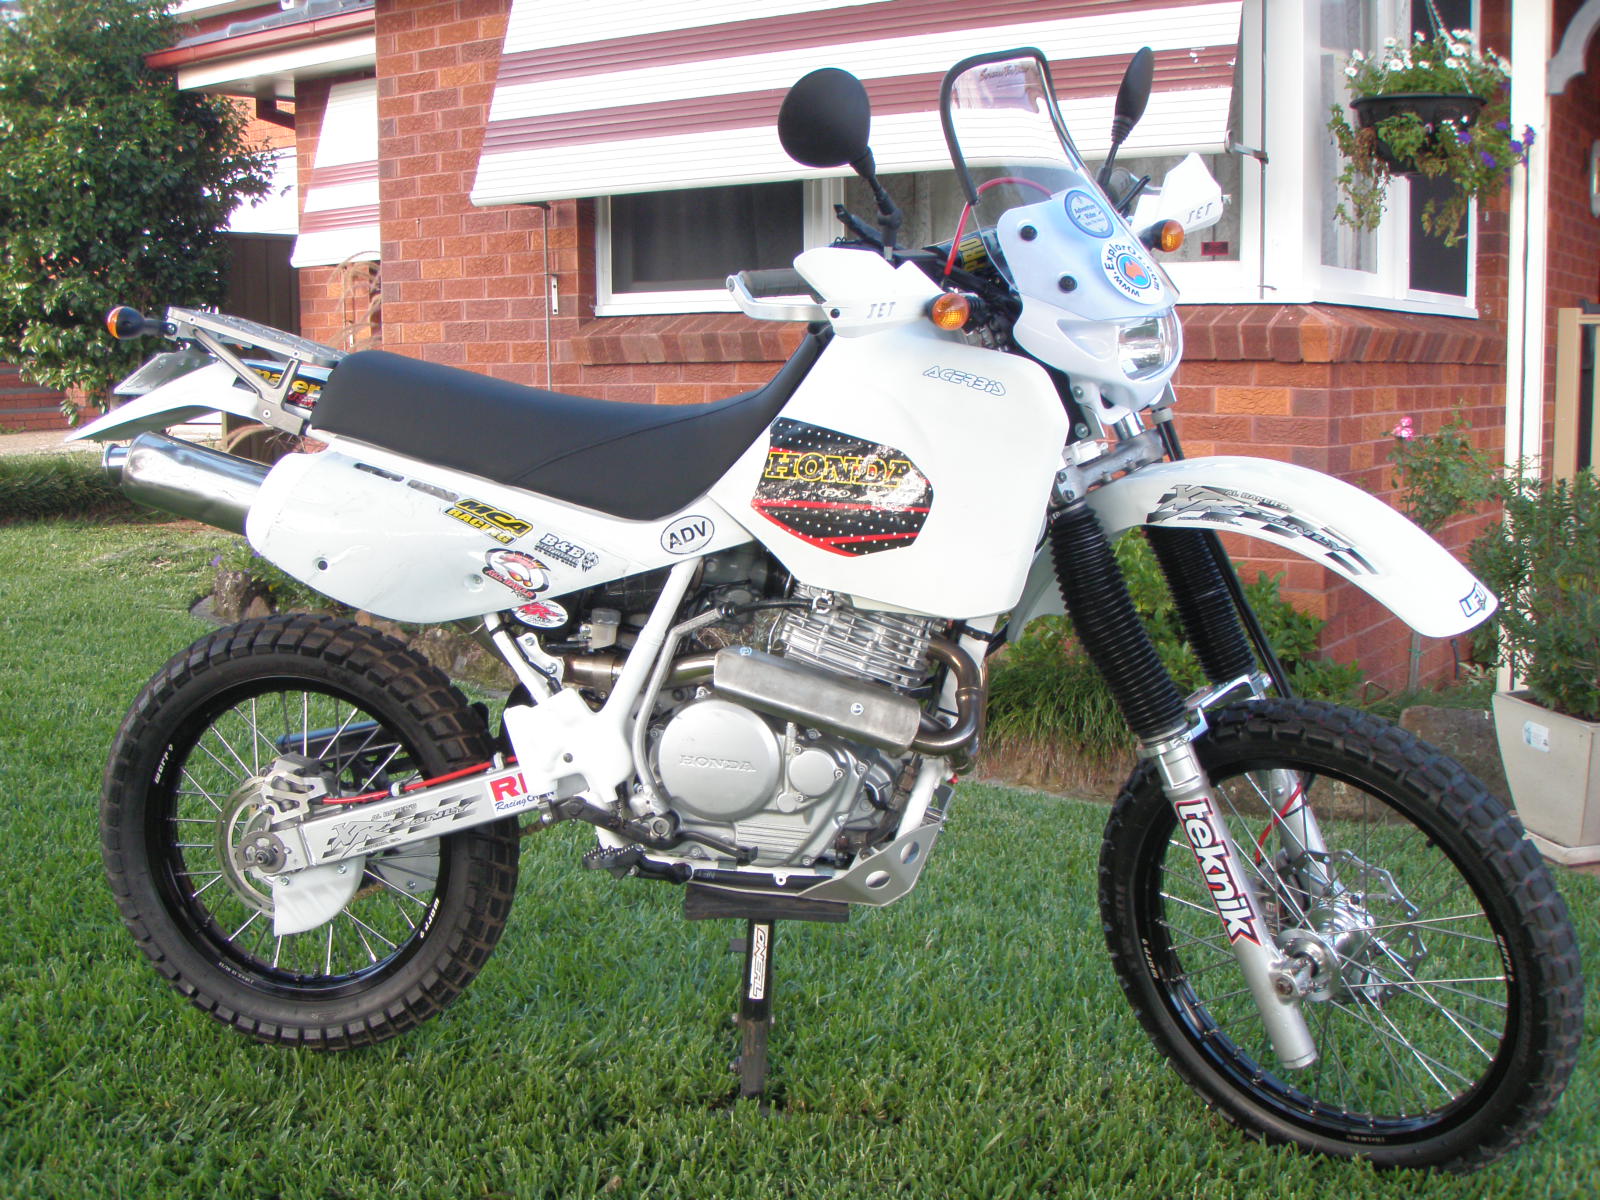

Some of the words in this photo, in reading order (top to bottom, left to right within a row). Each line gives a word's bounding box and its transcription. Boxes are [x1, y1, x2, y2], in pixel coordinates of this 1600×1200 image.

[867, 301, 896, 319] JET
[765, 452, 914, 488] HONDA
[446, 508, 515, 545] RACING
[456, 499, 533, 536] MCA
[540, 533, 586, 560] B&B
[668, 521, 707, 550] ADV
[679, 754, 757, 773] HONDA
[495, 798, 527, 812] Racing
[1176, 799, 1261, 945] teknik
